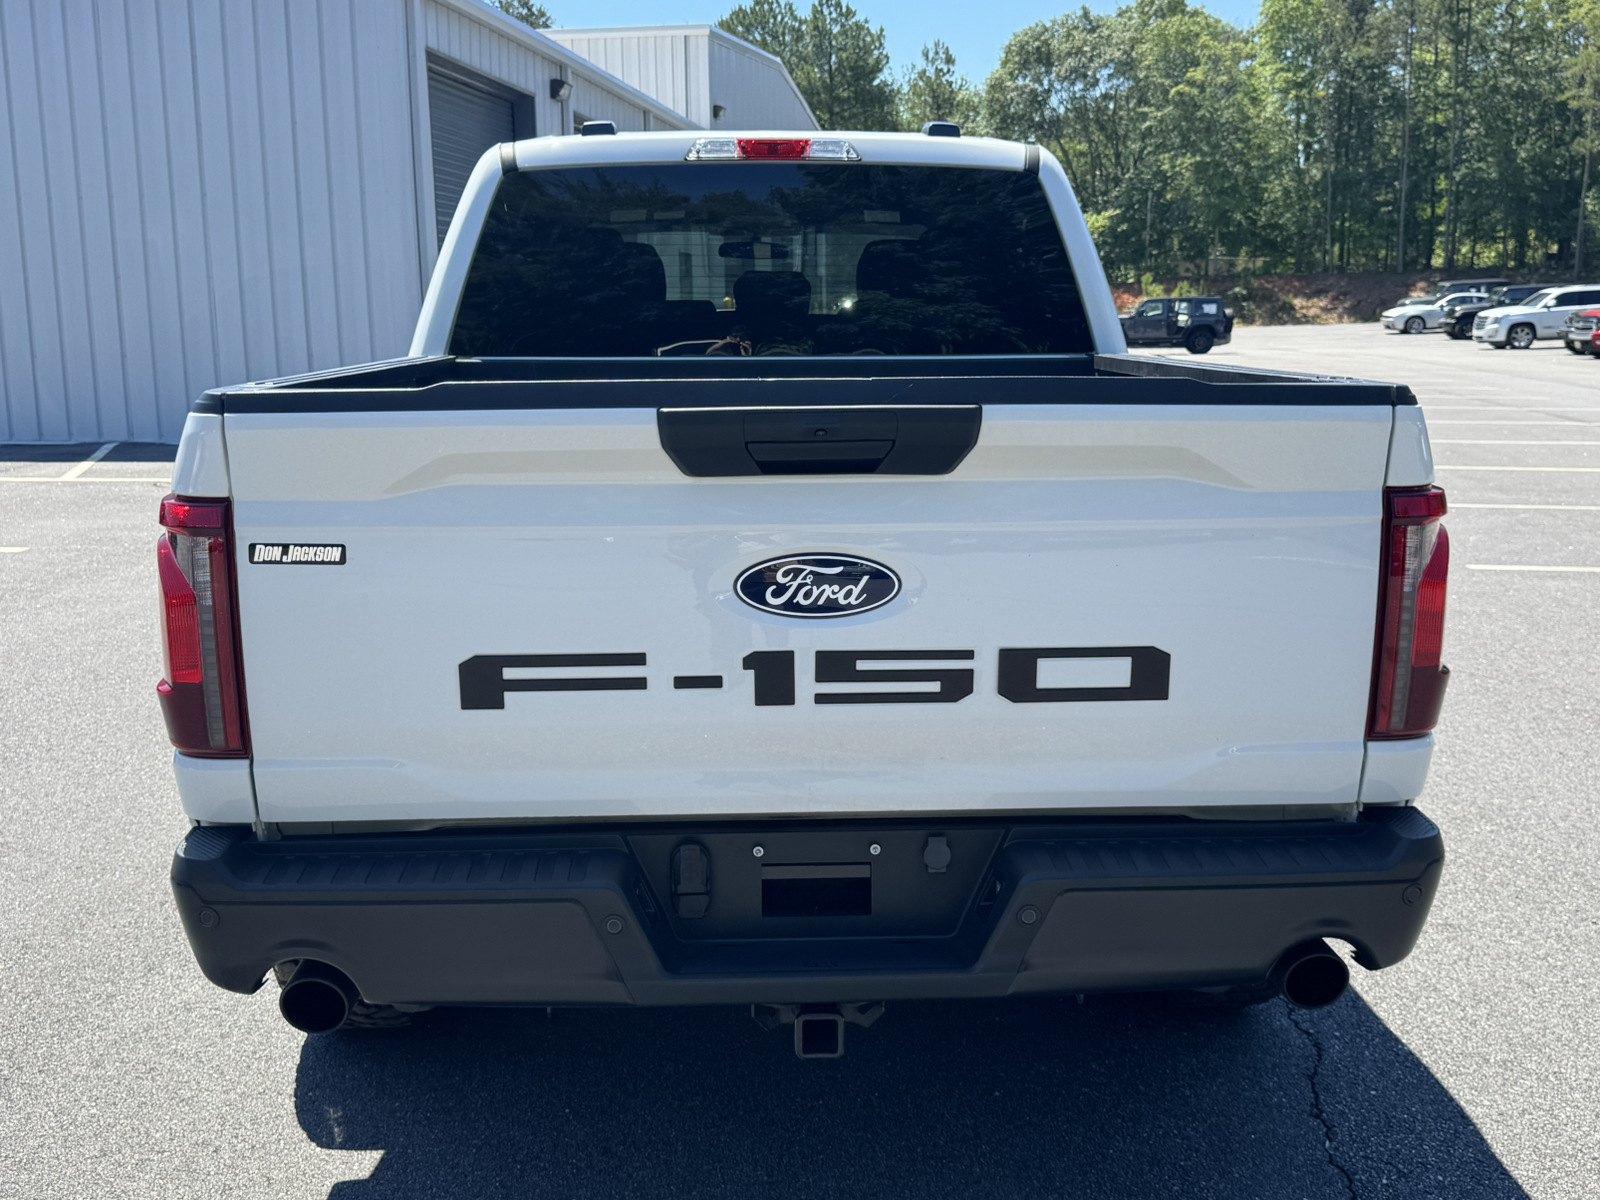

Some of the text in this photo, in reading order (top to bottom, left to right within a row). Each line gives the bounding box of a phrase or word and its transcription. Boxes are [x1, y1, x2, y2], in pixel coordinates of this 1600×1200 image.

[254, 545, 342, 562] DON JACKSON
[765, 564, 870, 606] Ford
[458, 645, 1171, 710] F-150
